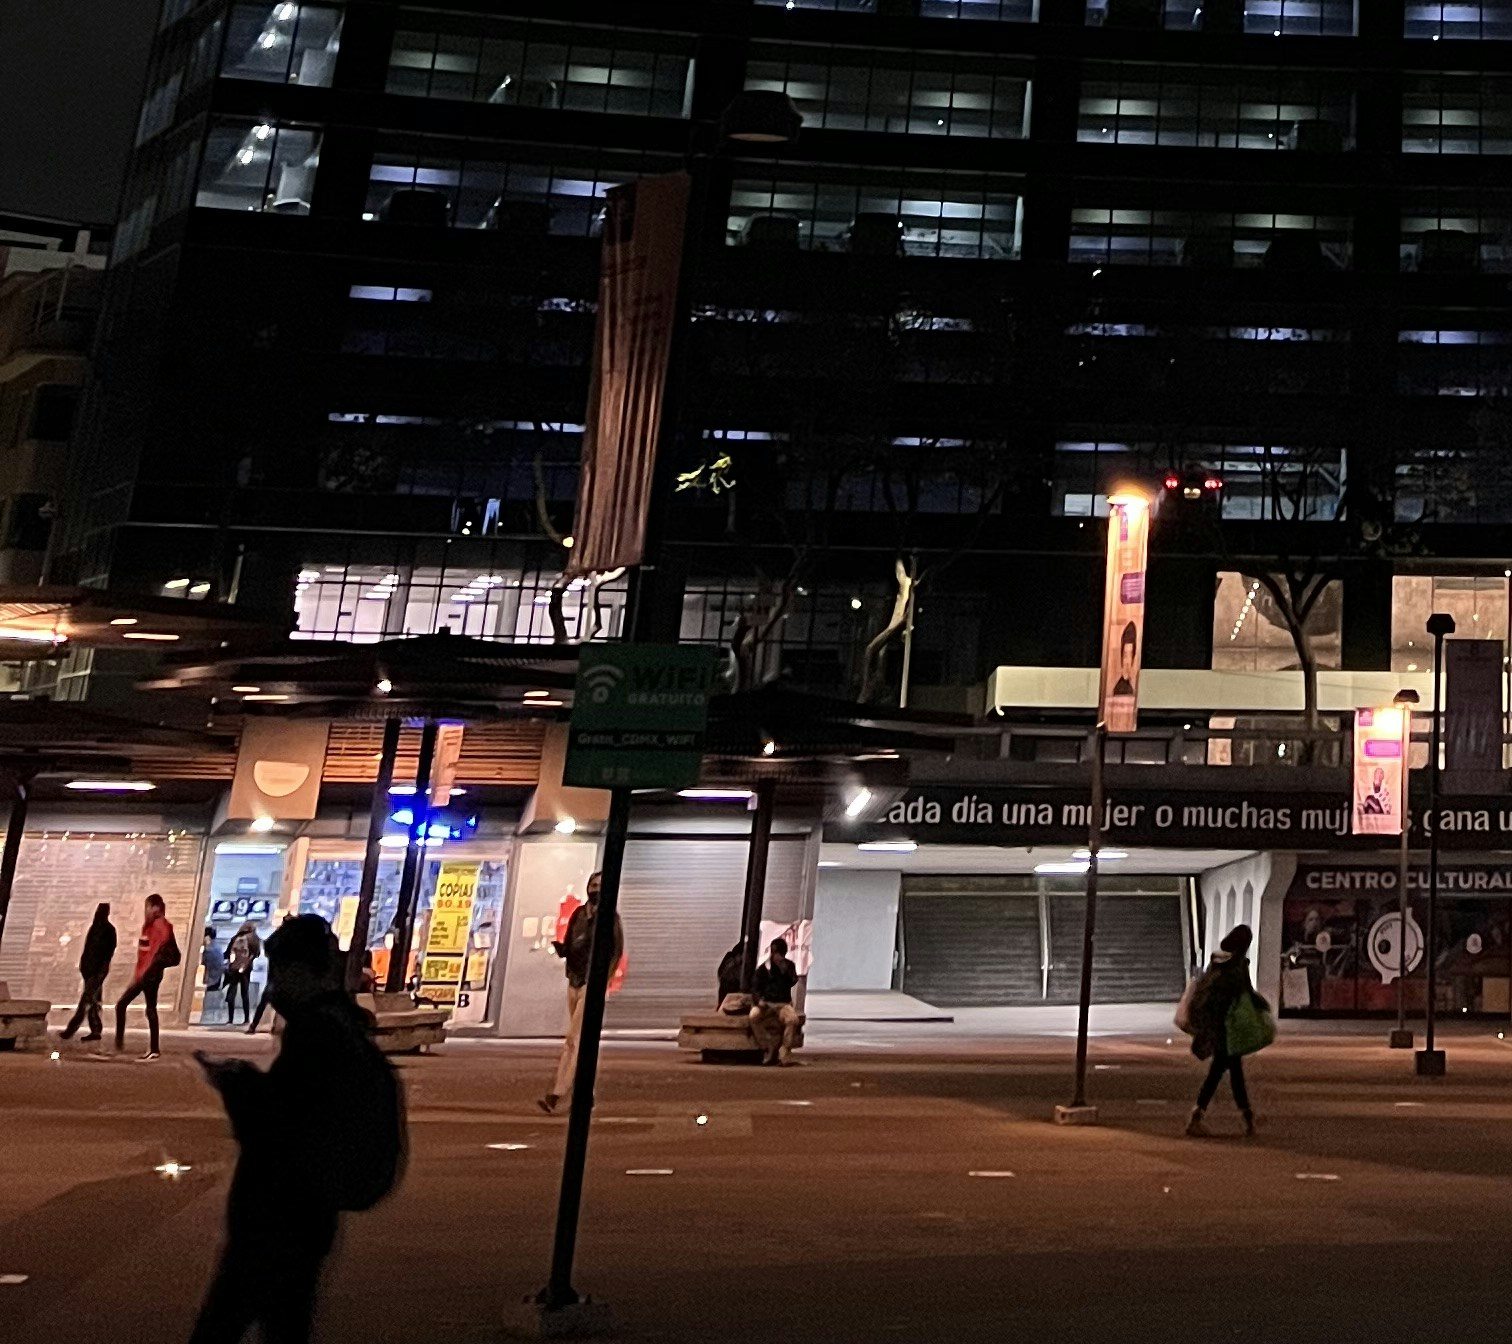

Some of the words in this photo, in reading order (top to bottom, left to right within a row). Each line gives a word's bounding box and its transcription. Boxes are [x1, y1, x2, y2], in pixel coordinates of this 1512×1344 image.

[627, 693, 705, 705] GRATUITO
[878, 796, 941, 824] ada
[951, 795, 993, 824] día
[1002, 802, 1053, 826] una
[1155, 804, 1174, 828] o
[1182, 801, 1291, 829] muchas
[1305, 871, 1397, 889] CENTRO
[439, 882, 475, 898] COPIAS
